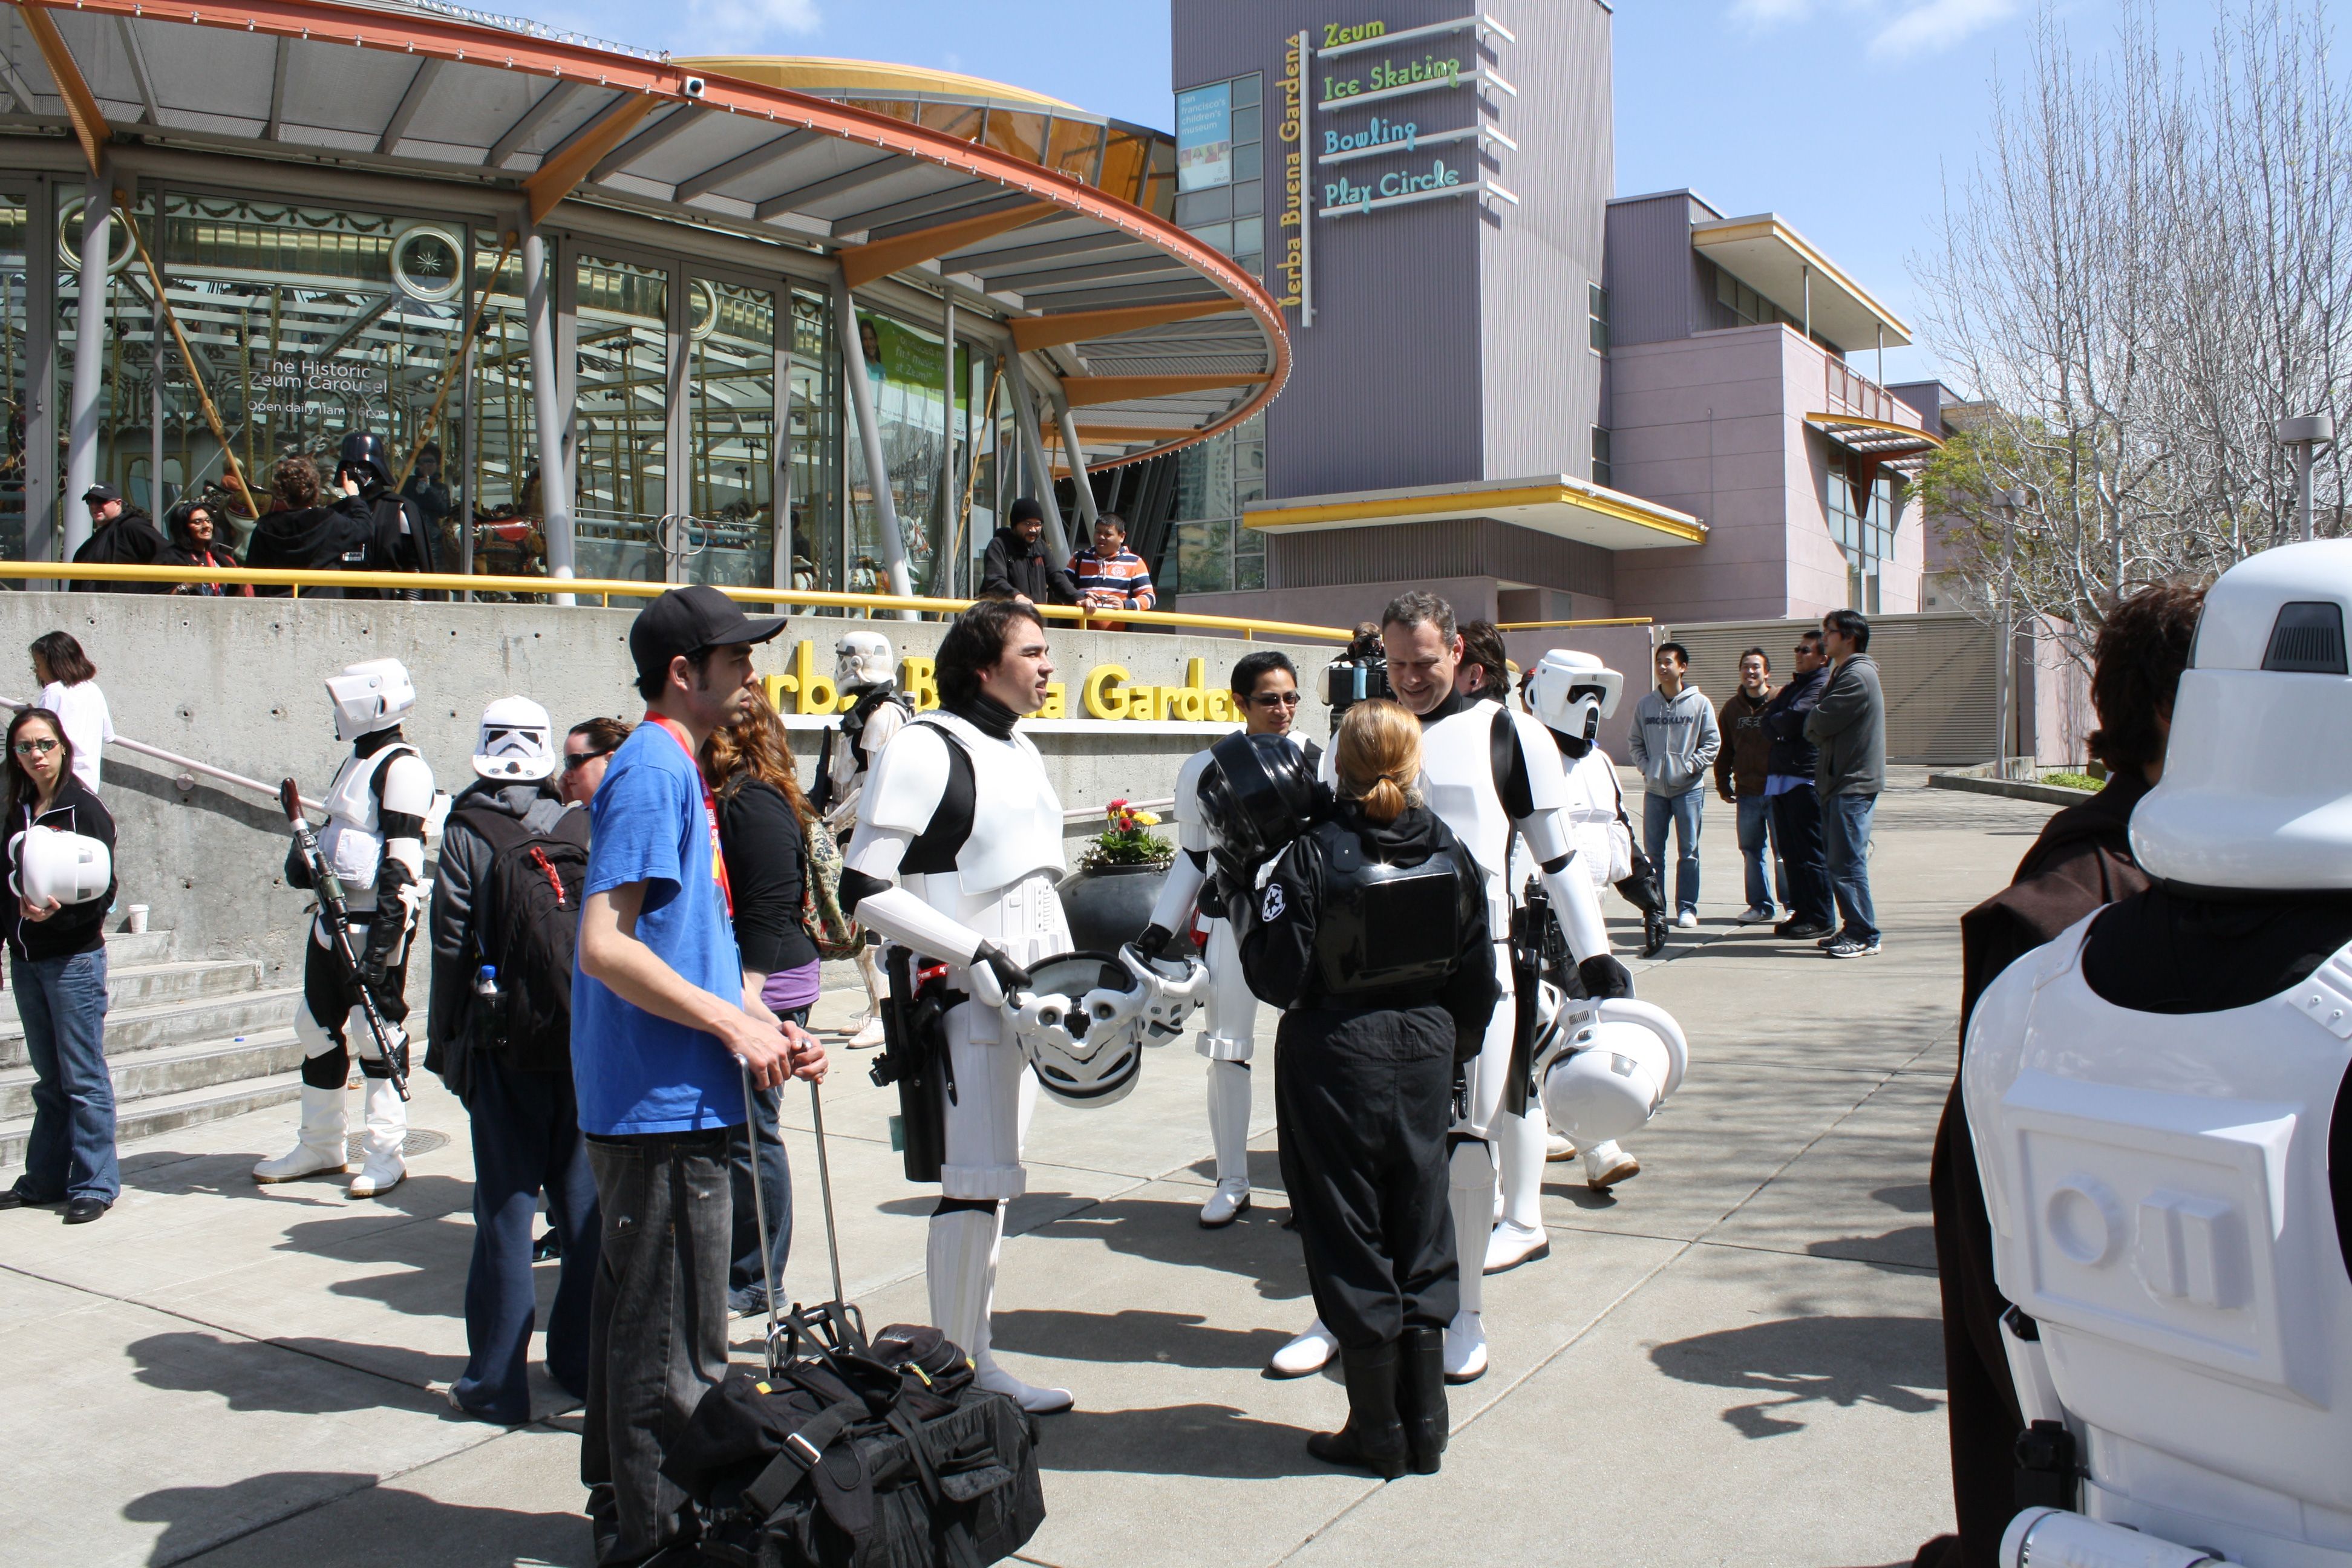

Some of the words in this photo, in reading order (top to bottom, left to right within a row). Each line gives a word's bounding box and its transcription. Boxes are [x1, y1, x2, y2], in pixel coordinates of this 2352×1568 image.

[1324, 20, 1385, 48] Zeum
[1275, 34, 1300, 142] Gardens
[1324, 76, 1361, 100] Ice
[1370, 54, 1460, 88] Skating
[1181, 96, 1195, 105] san
[1181, 99, 1226, 114] francisco's
[1181, 110, 1221, 125] children's
[1181, 122, 1217, 135] museum
[1324, 117, 1417, 154] Bowling
[1280, 152, 1301, 227] Buena
[1325, 177, 1372, 214] Play
[1380, 159, 1459, 197] Circle
[1276, 238, 1301, 309] Yerba
[261, 358, 295, 374] The
[302, 361, 370, 379] Historic
[249, 371, 301, 388] Zeum
[309, 375, 388, 393] Carousel
[247, 400, 281, 413] Open
[286, 402, 314, 415] daily
[318, 405, 345, 416] 11am
[1645, 716, 1694, 725] BROOKLYN
